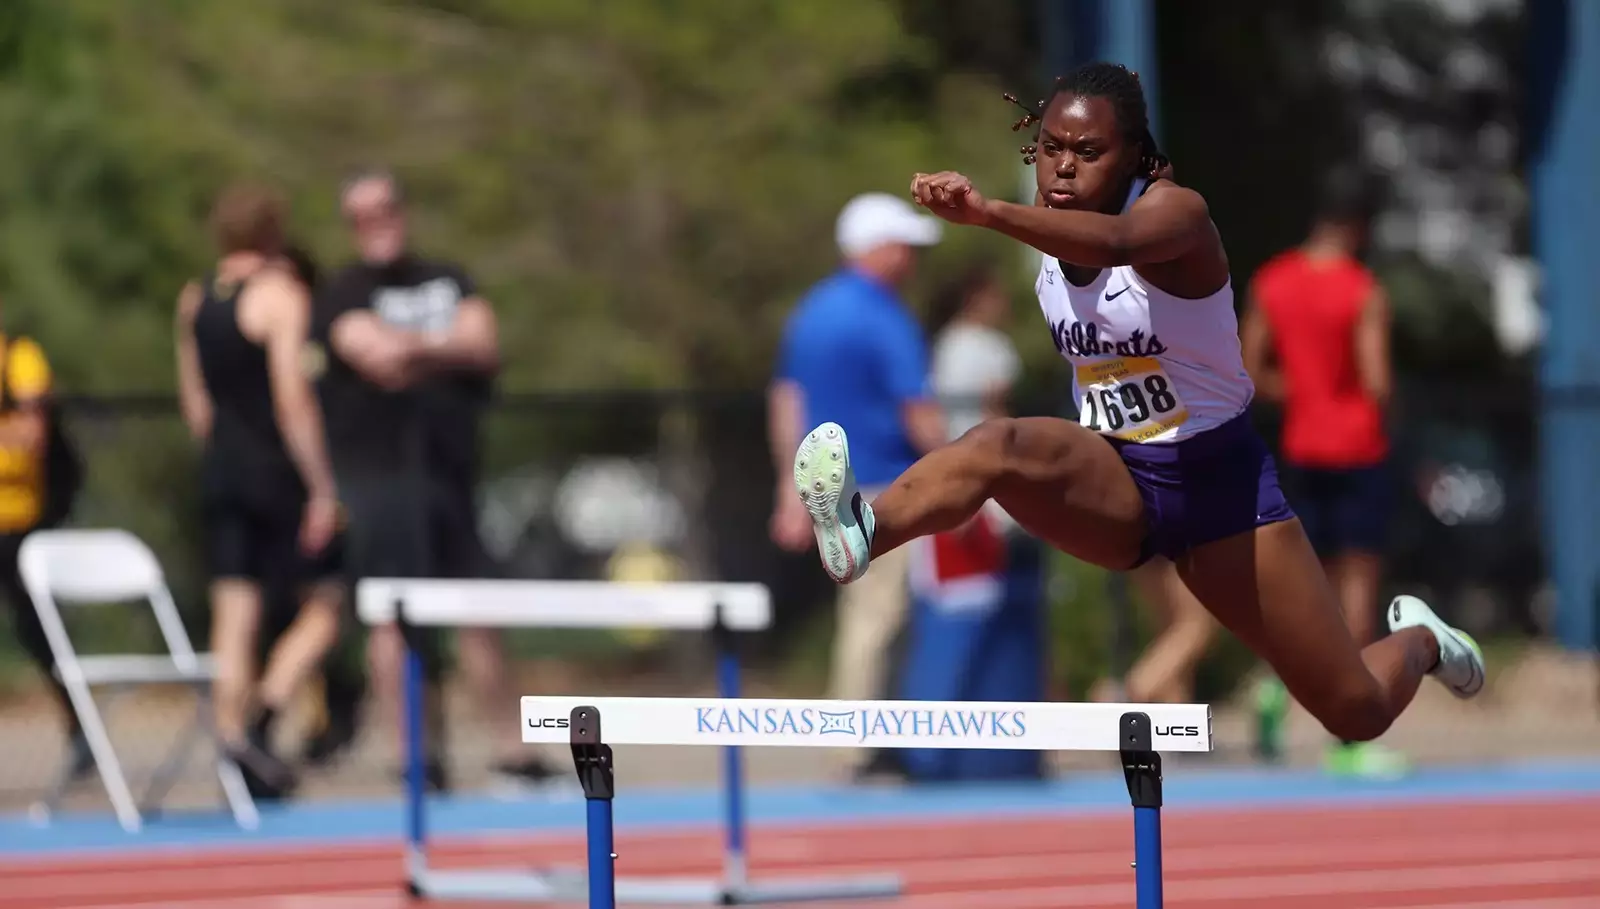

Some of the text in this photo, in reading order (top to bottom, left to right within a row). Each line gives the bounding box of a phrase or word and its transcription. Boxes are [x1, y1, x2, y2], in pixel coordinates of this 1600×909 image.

[1086, 374, 1177, 431] 1698
[528, 718, 570, 728] UCS
[696, 708, 815, 735] KANSAS
[858, 709, 1026, 743] JAYHAWKS
[1155, 725, 1199, 736] UCS
